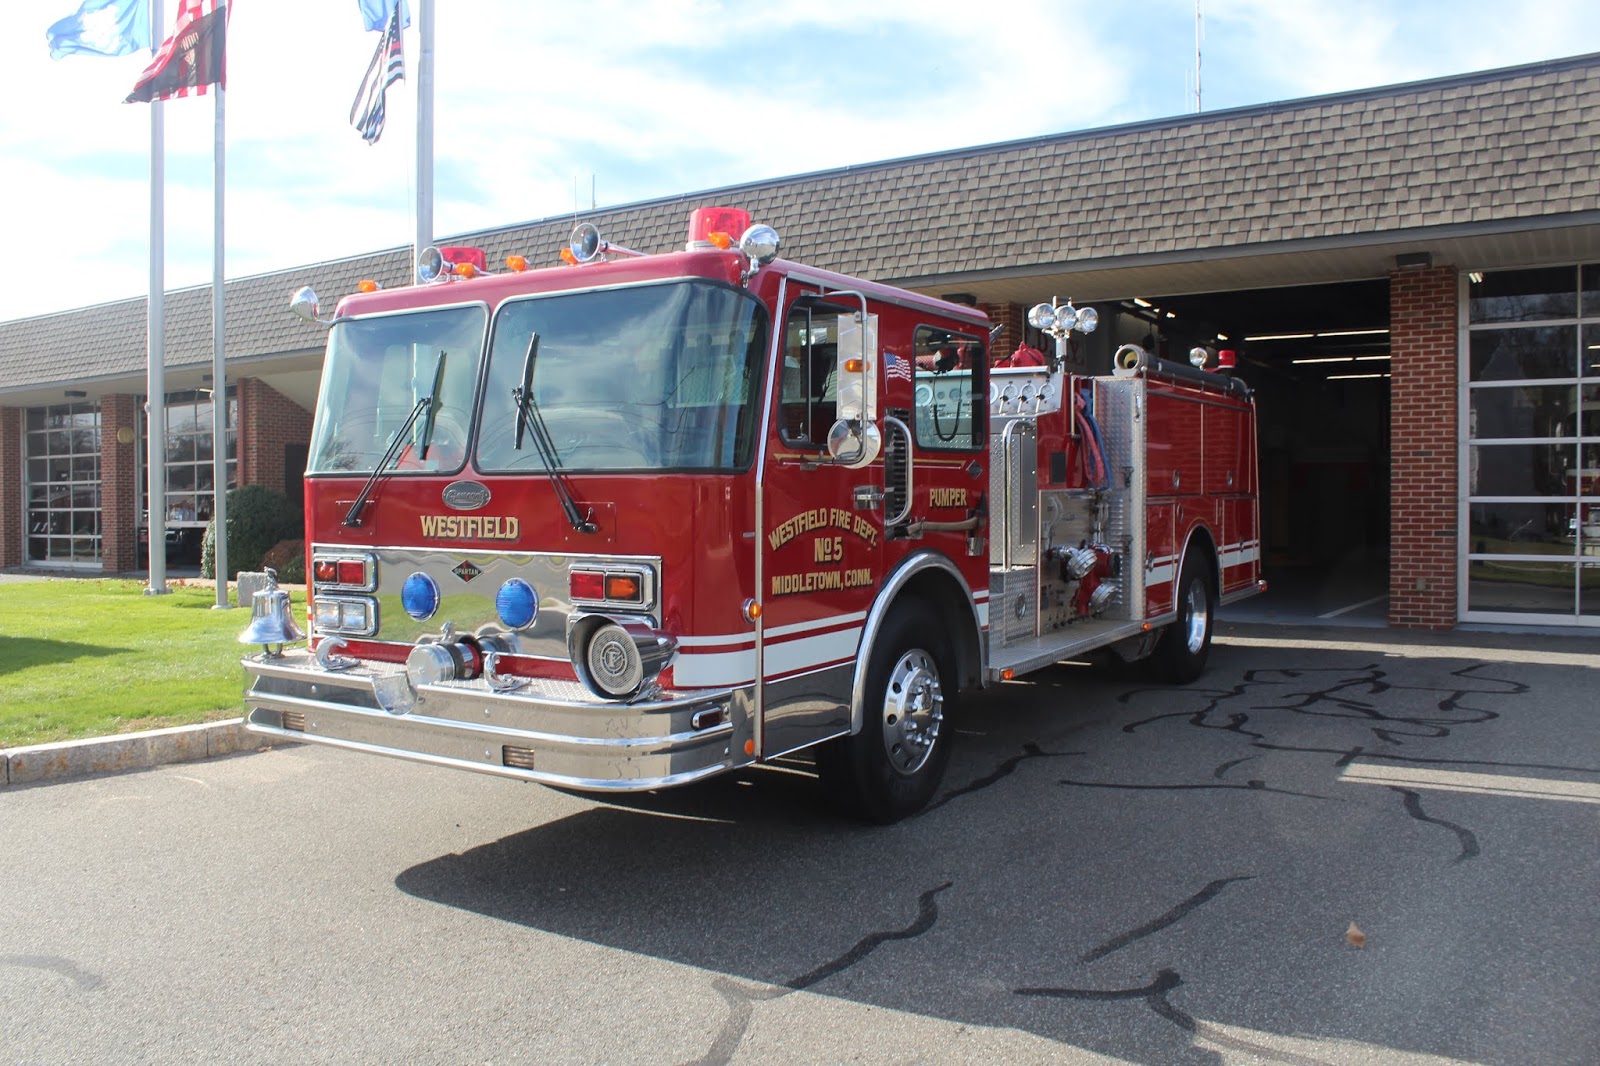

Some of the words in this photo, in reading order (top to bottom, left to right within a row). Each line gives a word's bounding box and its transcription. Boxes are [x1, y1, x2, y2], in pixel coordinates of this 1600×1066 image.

[929, 488, 967, 507] PUMPER
[420, 515, 520, 540] WESTFIELD
[768, 508, 828, 551] WESTFIELD
[830, 508, 852, 530] FIRE
[853, 514, 878, 547] DEPT.
[454, 567, 479, 575] SPARTAN
[772, 572, 844, 595] MIDDLETOWN,
[845, 568, 873, 587] CONN.
